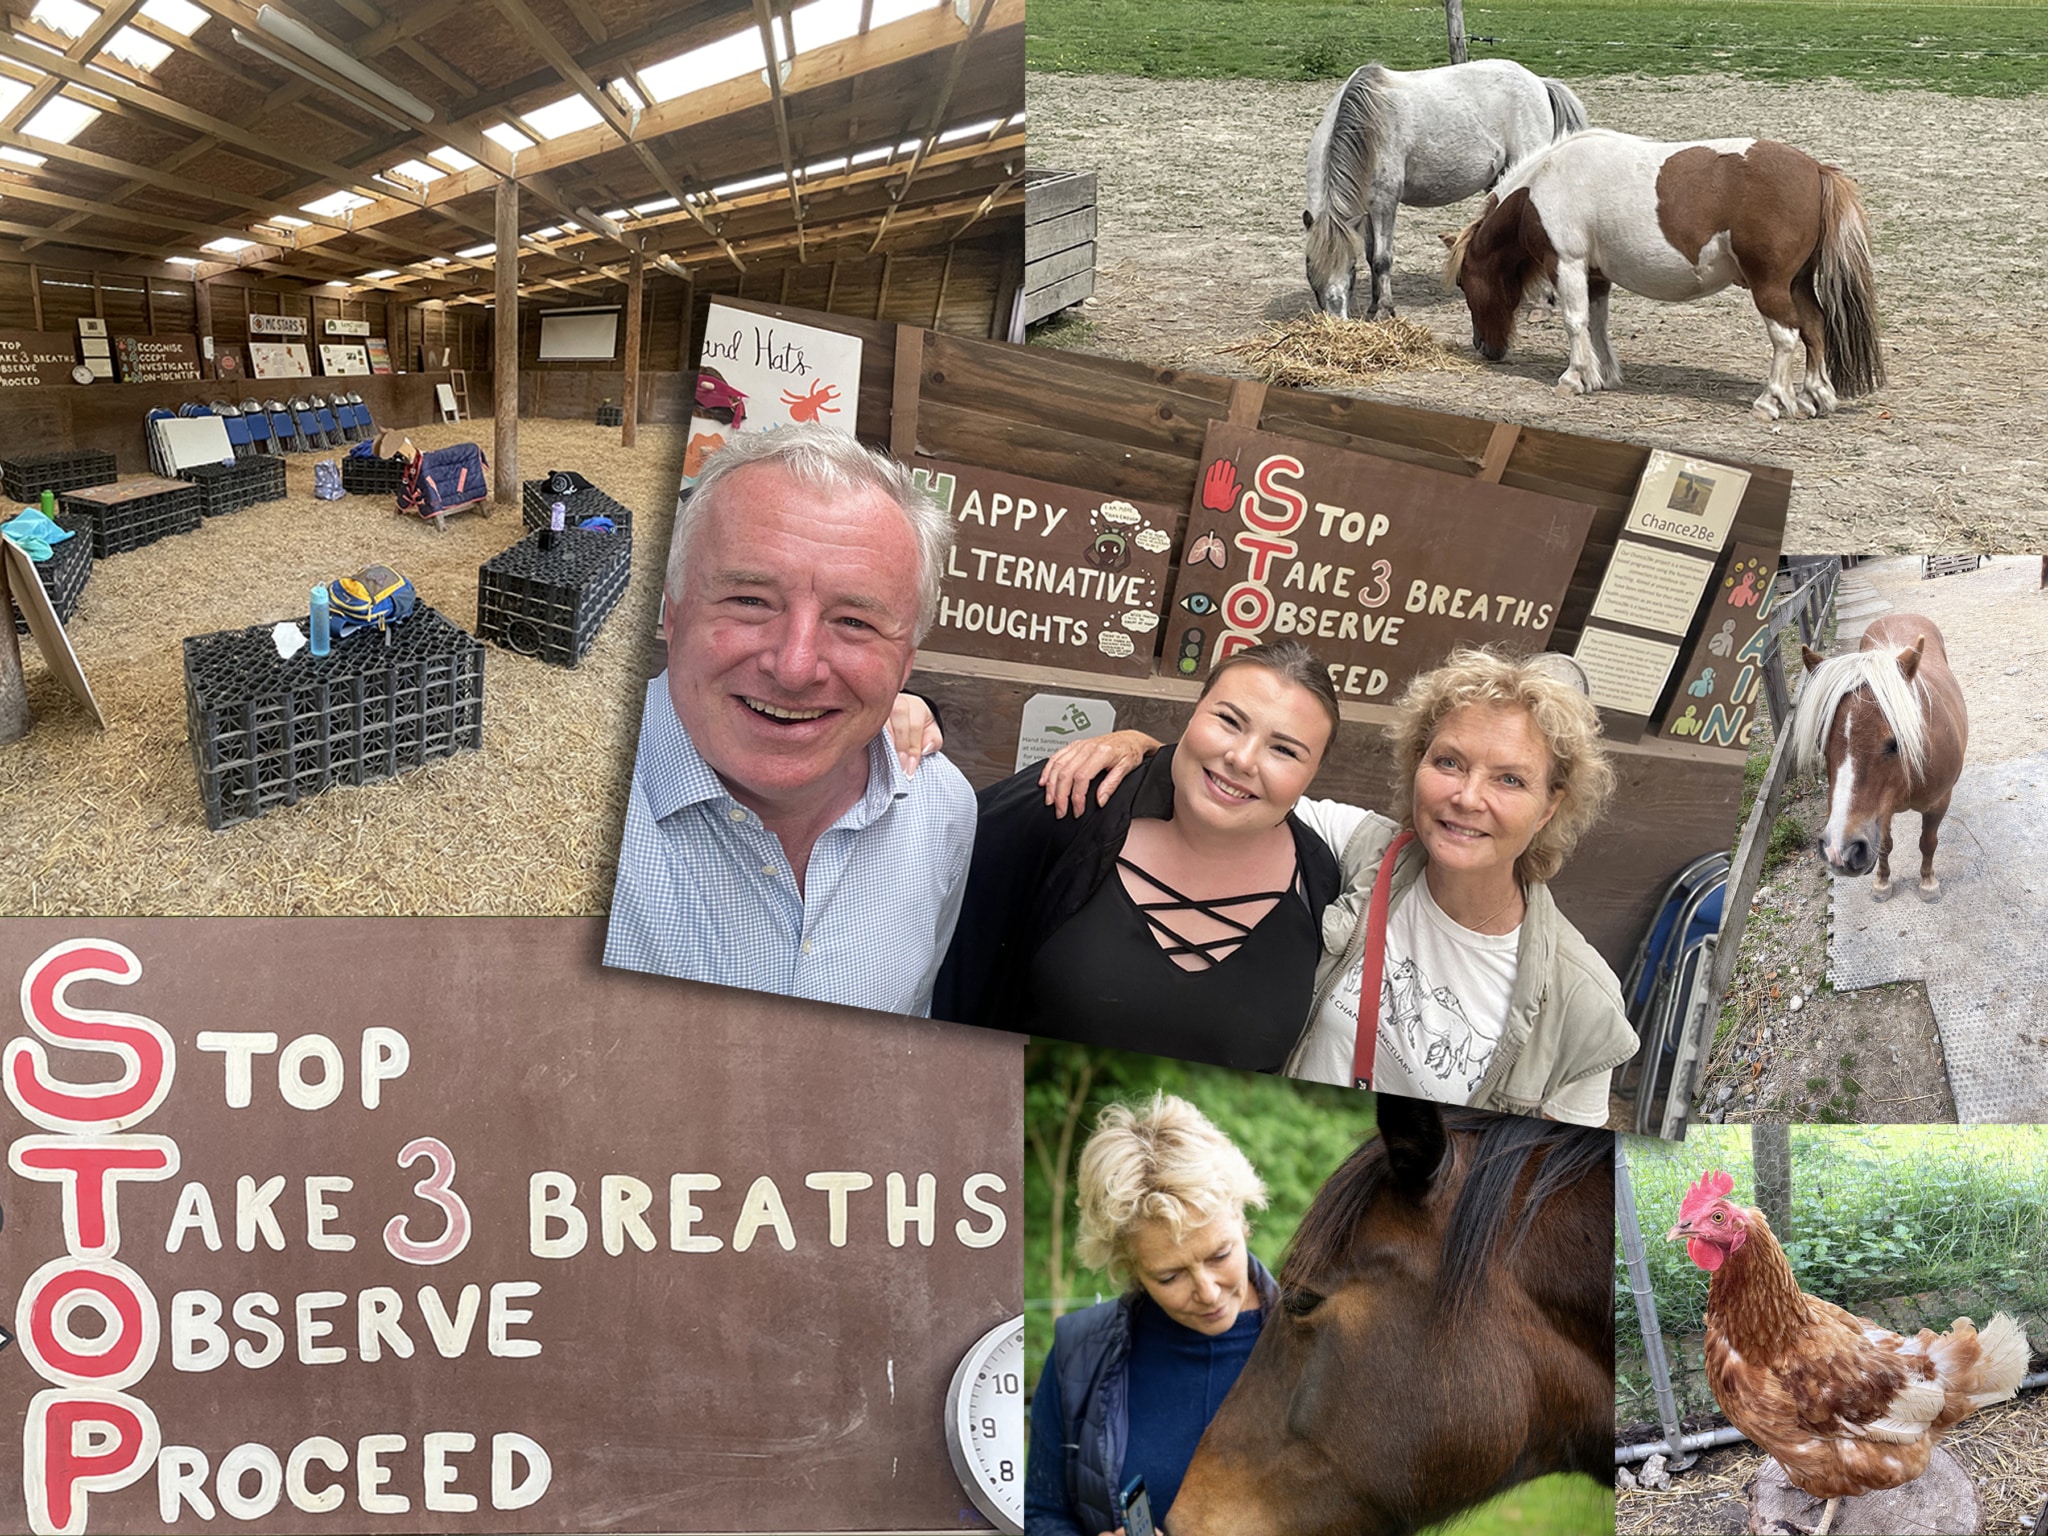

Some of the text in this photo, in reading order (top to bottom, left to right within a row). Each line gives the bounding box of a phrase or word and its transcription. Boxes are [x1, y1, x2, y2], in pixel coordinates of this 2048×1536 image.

[0, 341, 22, 350] TOP
[127, 338, 183, 353] RECOGNISE
[129, 350, 166, 363] ACCEPT
[754, 326, 812, 376] Hats
[0, 354, 18, 363] AKE
[33, 354, 76, 363] BREATHS
[0, 364, 38, 374] BSERVE
[133, 361, 195, 372] INVESTIGATE
[0, 376, 41, 387] ROCEED
[1641, 512, 1715, 542] Chance2Be
[947, 544, 1146, 606] LTERNATIVE
[1358, 559, 1392, 609] 3
[1405, 579, 1553, 631] BREATHS
[937, 595, 1089, 647] HOUGHTS
[1334, 1000, 1359, 1022] CHAN
[1376, 1029, 1414, 1076] ANCTUARY
[383, 1136, 472, 1266] 3
[529, 1170, 1008, 1260] BREATHS
[992, 1373, 1019, 1395] 10
[981, 1417, 997, 1439] 9
[999, 1460, 1014, 1482] 8
